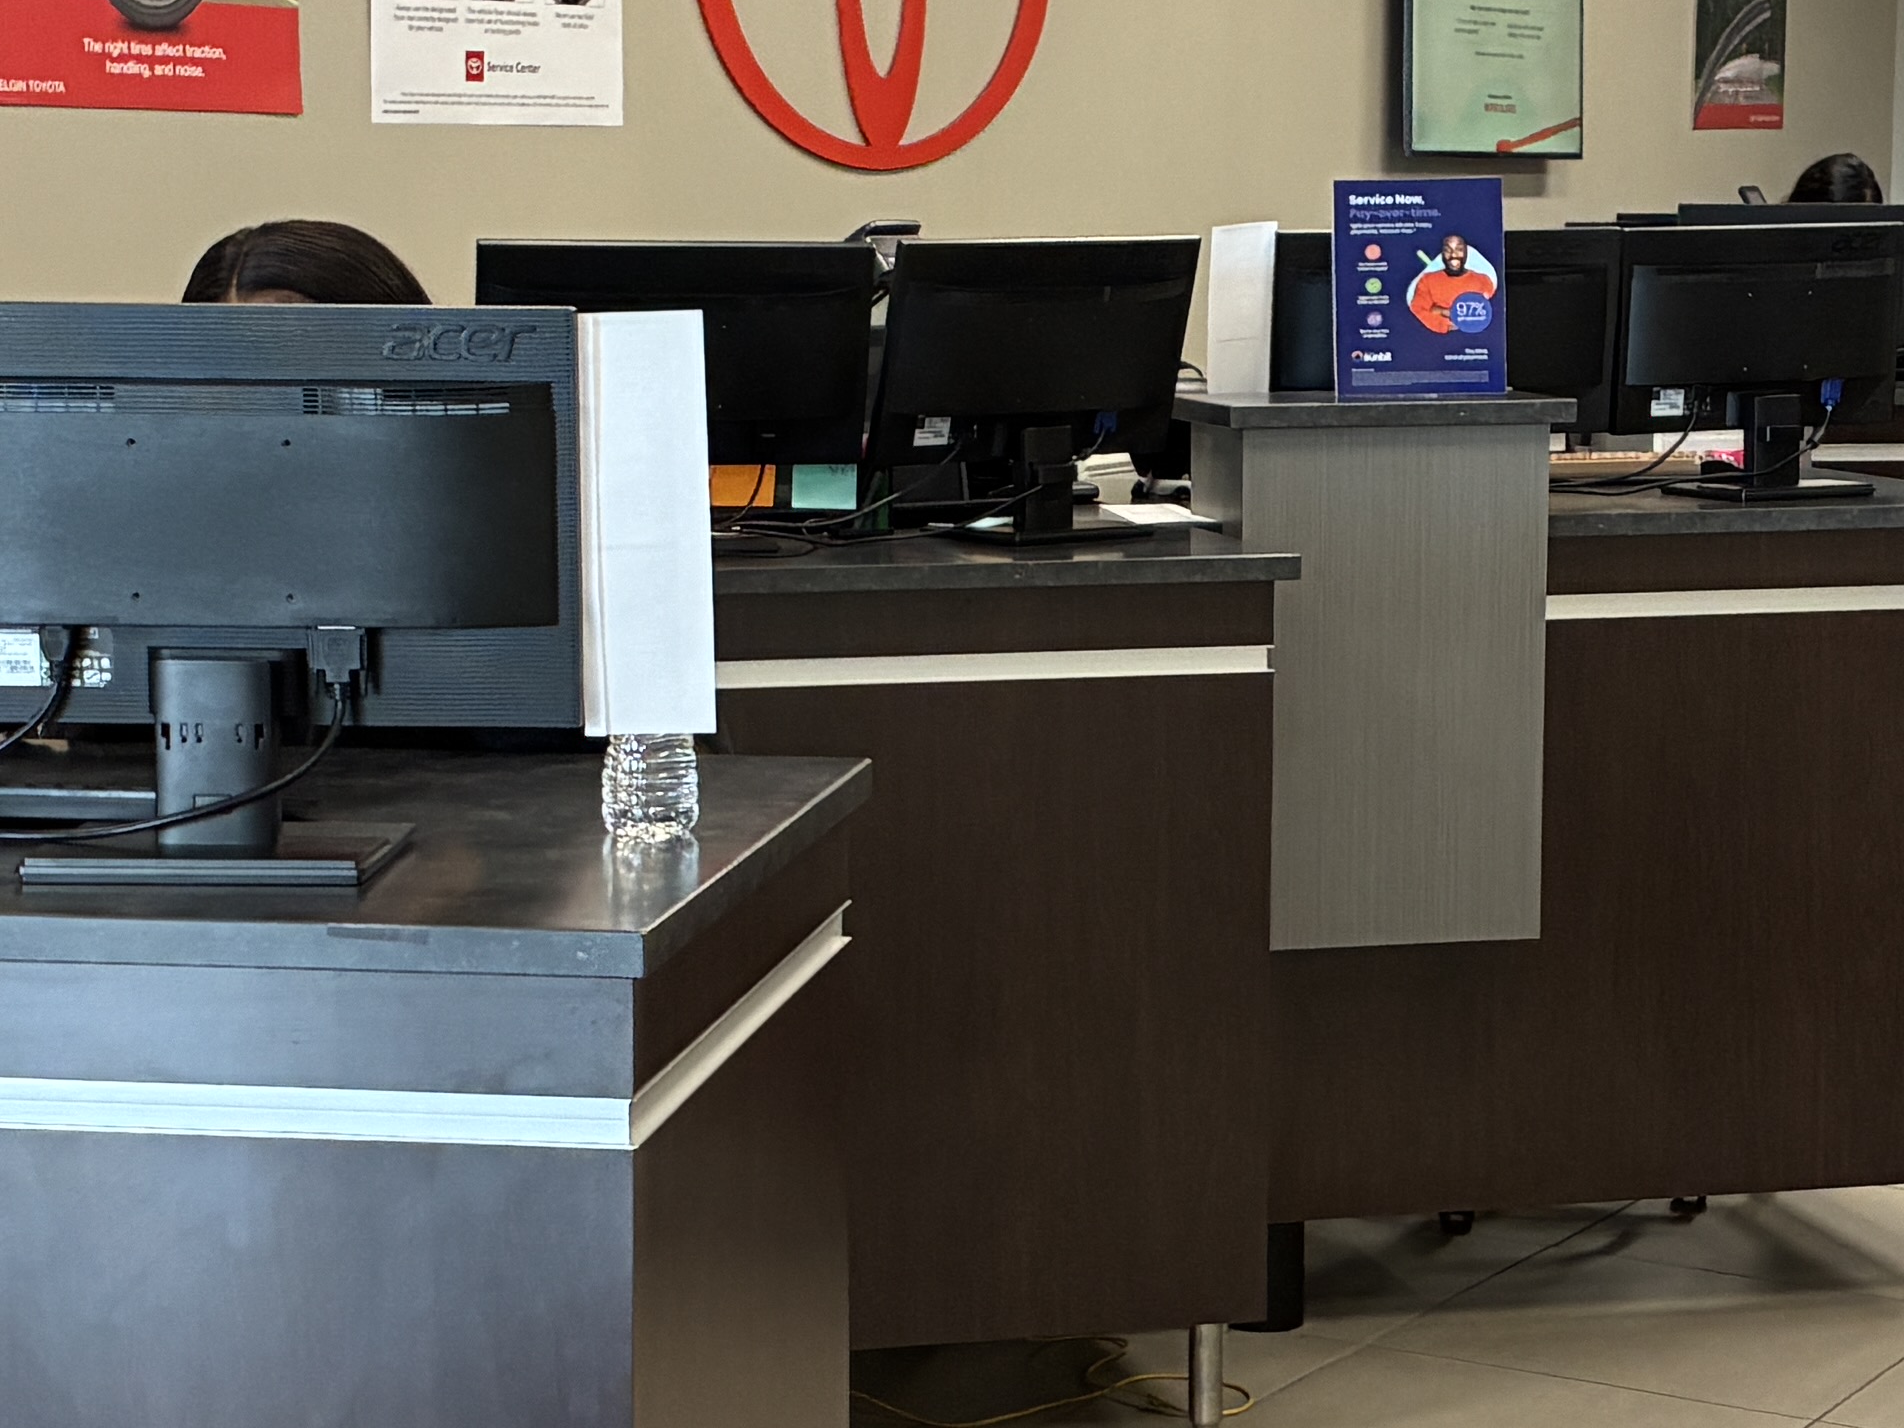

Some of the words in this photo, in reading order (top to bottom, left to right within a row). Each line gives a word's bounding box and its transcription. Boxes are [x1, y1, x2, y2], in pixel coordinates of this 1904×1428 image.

[83, 38, 102, 54] The
[105, 41, 128, 58] right
[130, 41, 152, 56] tires
[155, 42, 183, 57] affect
[185, 44, 226, 60] traction,
[105, 59, 152, 78] handling,
[154, 63, 174, 76] and
[487, 62, 513, 72] Service
[515, 62, 541, 73] Center
[28, 81, 66, 94] TOYOTA
[1349, 194, 1393, 206] Service
[1456, 302, 1486, 316] 97%
[380, 320, 537, 363] acer
